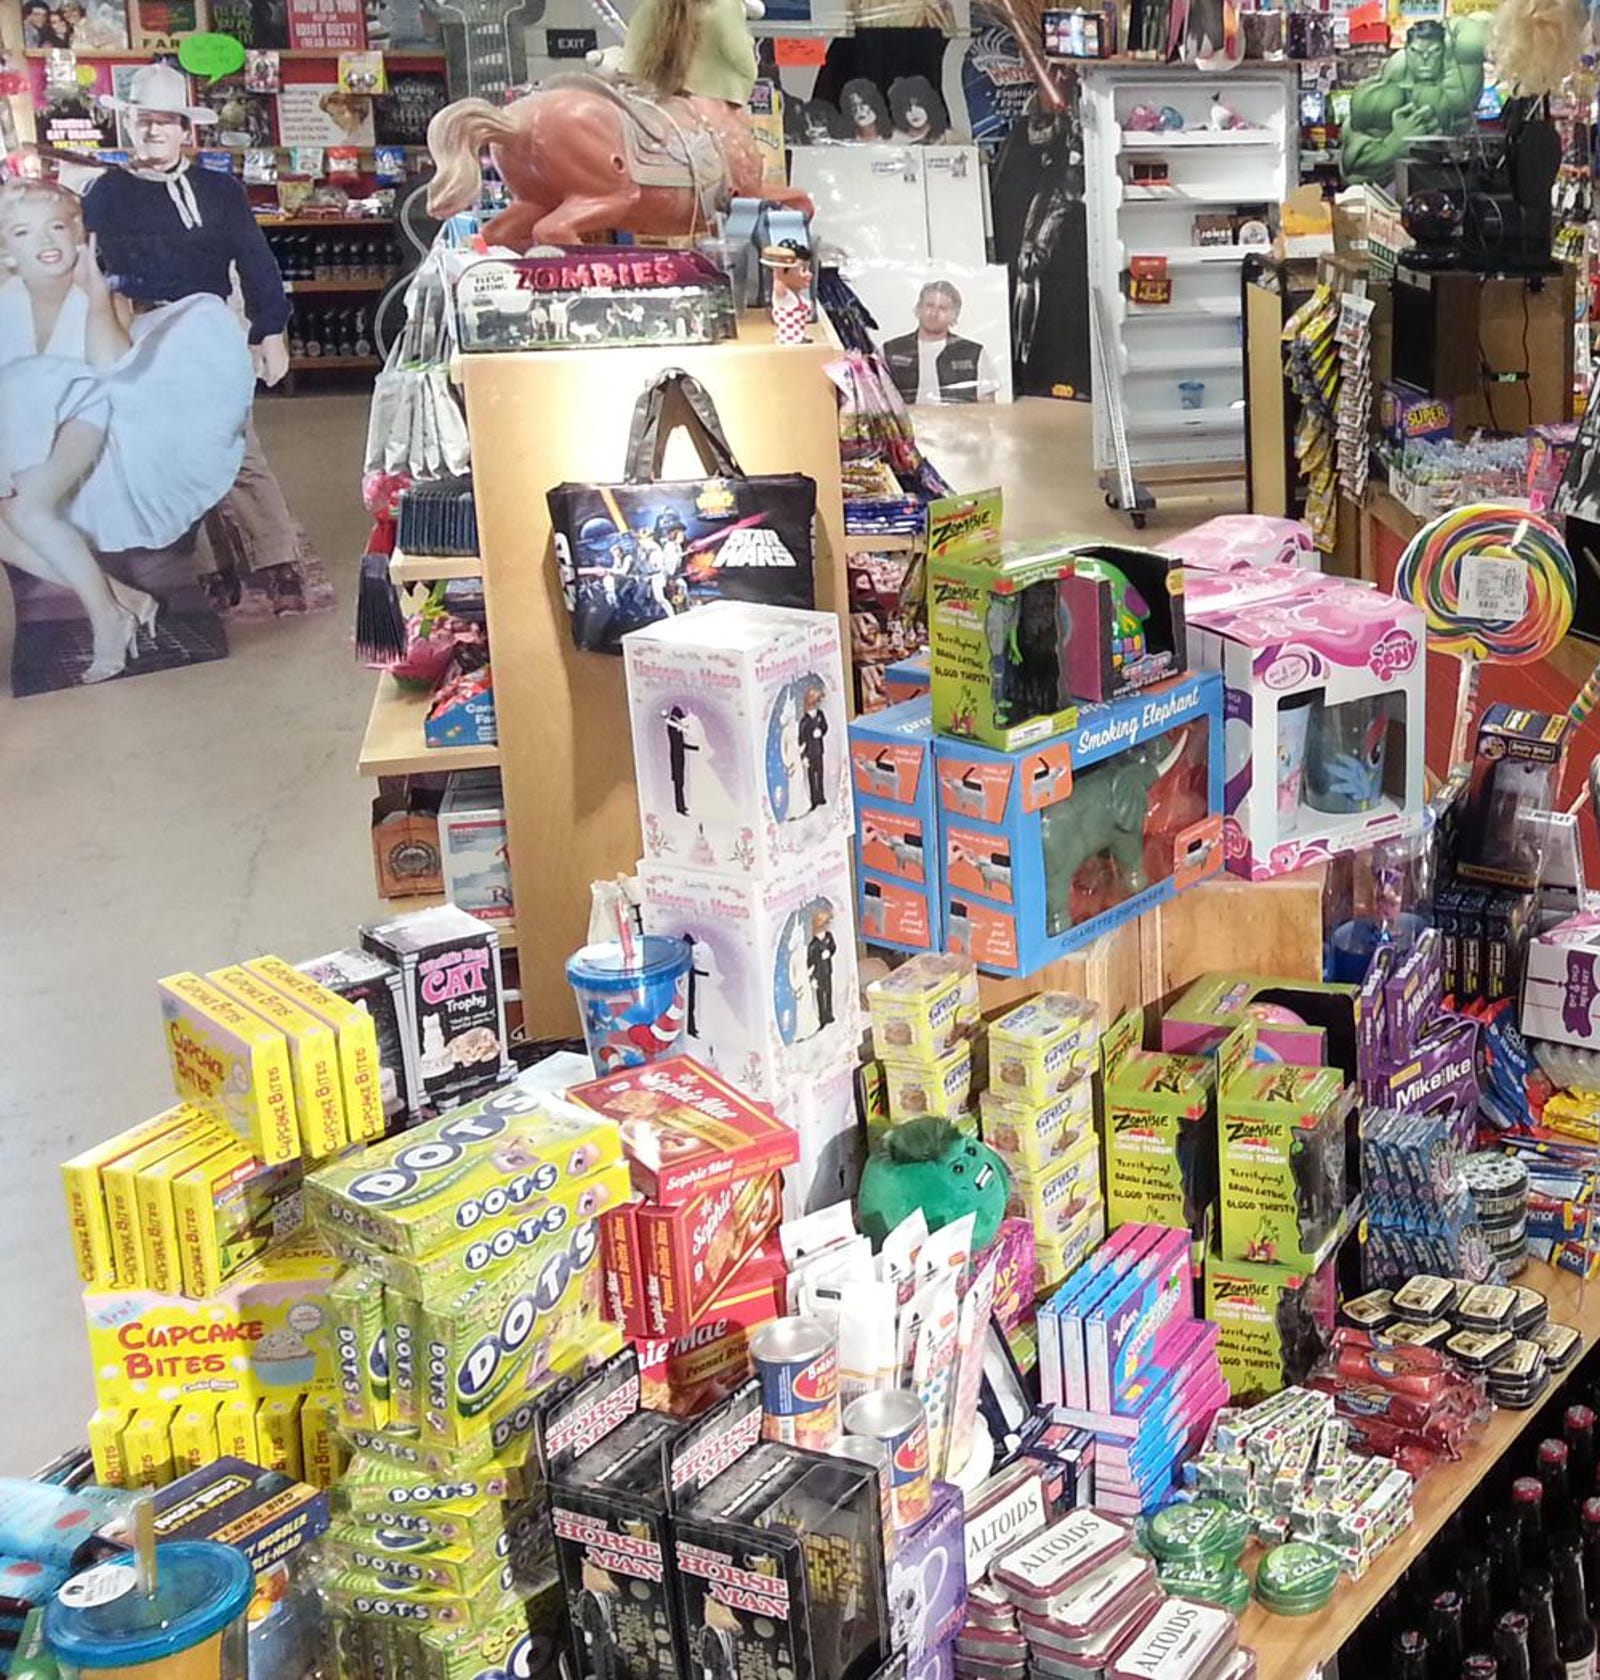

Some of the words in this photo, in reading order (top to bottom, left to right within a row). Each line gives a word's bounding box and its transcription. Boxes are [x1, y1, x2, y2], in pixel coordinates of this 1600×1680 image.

[557, 37, 587, 51] EXIT
[515, 260, 677, 291] ZOMBIES
[1407, 405, 1448, 427] SUPER
[728, 528, 780, 546] STAR
[932, 510, 992, 550] ZOMBIE
[711, 544, 797, 568] WARS
[933, 583, 981, 605] ZOMBIE
[1368, 640, 1418, 681] PONY
[1077, 716, 1140, 754] Smoking
[1142, 686, 1200, 727] Elephant
[421, 960, 490, 1005] CAT
[445, 993, 488, 1013] Trophy
[268, 1066, 285, 1106] BITES
[315, 1060, 330, 1100] BITES
[355, 1046, 370, 1087] BITES
[1396, 1072, 1442, 1111] Mike
[1446, 1058, 1472, 1084] Ike
[1112, 1113, 1169, 1133] ZOMBIE
[1226, 1122, 1283, 1142] ZOMBIE
[348, 1090, 541, 1205] DOTS
[1115, 1158, 1171, 1177] Terrifying!
[456, 1162, 559, 1228] DOTS
[666, 1166, 708, 1191] Sophie
[1229, 1167, 1285, 1186] Terrifying!
[465, 1205, 568, 1271] DOTS
[456, 1216, 600, 1398] DOTS
[1213, 1282, 1270, 1300] ZOMBIE
[118, 1321, 265, 1351] CUPCAKE
[675, 1317, 728, 1356] Mae
[1220, 1327, 1270, 1344] errifying!
[122, 1352, 227, 1381] BITES
[338, 1326, 362, 1394] DOTS
[393, 1324, 413, 1390] DOTS
[429, 1341, 448, 1410] DOTS
[684, 1351, 726, 1380] Peanut
[546, 1374, 639, 1459] HORSE
[574, 1393, 640, 1458] MAN
[104, 1444, 125, 1485] BITES
[313, 1430, 331, 1466] BITES
[354, 1434, 419, 1462] DOTS
[671, 1405, 764, 1491] HORSE
[697, 1423, 760, 1490] MAN
[388, 1482, 478, 1503] DOTS
[257, 1513, 309, 1554] WOBBLER
[553, 1517, 662, 1562] HORSE
[967, 1491, 1041, 1558] ALTOIDS
[354, 1551, 423, 1579] DOTS
[586, 1546, 663, 1582] MAN
[1018, 1517, 1102, 1573] ALTOIDS
[677, 1552, 788, 1600] HORSE
[354, 1597, 430, 1620] DOTS
[709, 1582, 790, 1621] MAN
[1136, 1604, 1199, 1674] ALTOIDS
